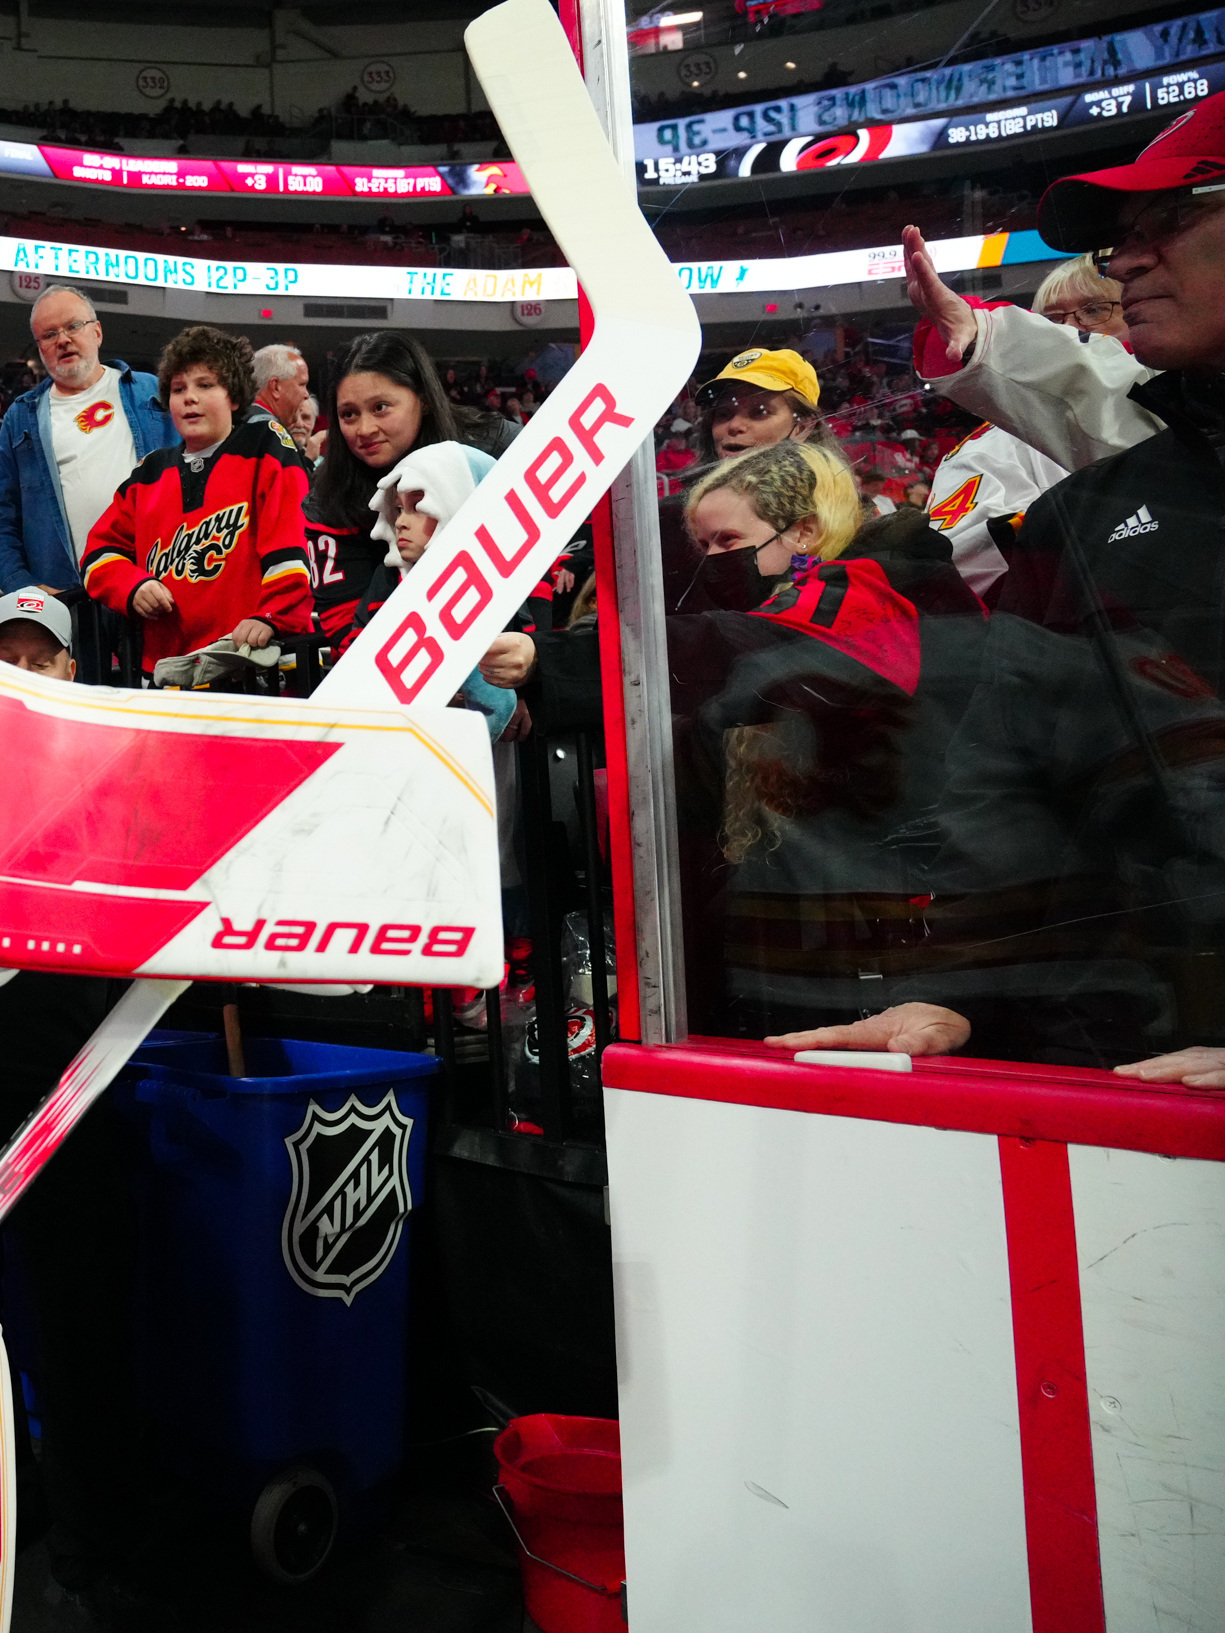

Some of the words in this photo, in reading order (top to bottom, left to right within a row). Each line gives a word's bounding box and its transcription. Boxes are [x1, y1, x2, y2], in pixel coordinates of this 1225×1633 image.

[139, 75, 166, 91] 332
[1157, 79, 1209, 105] 52.68
[1088, 96, 1133, 118] +37
[1027, 110, 1058, 131] PTS)
[643, 153, 717, 179] 15:43
[142, 174, 177, 186] KADRI
[185, 175, 208, 187] 200
[245, 175, 266, 190] +3
[288, 176, 323, 192] 50.00
[355, 178, 395, 192] 31-27-5
[416, 176, 441, 192] PTS)
[15, 242, 195, 286] AFTERNOONS
[207, 264, 299, 291] 12P-3P
[867, 250, 897, 262] 99.9
[18, 275, 41, 290] 125
[406, 271, 454, 296] THE
[463, 272, 543, 298] ADAM
[520, 303, 542, 316] 126
[146, 501, 250, 580] Calgary
[1107, 519, 1160, 544] adidas
[315, 1147, 391, 1263] NHL
